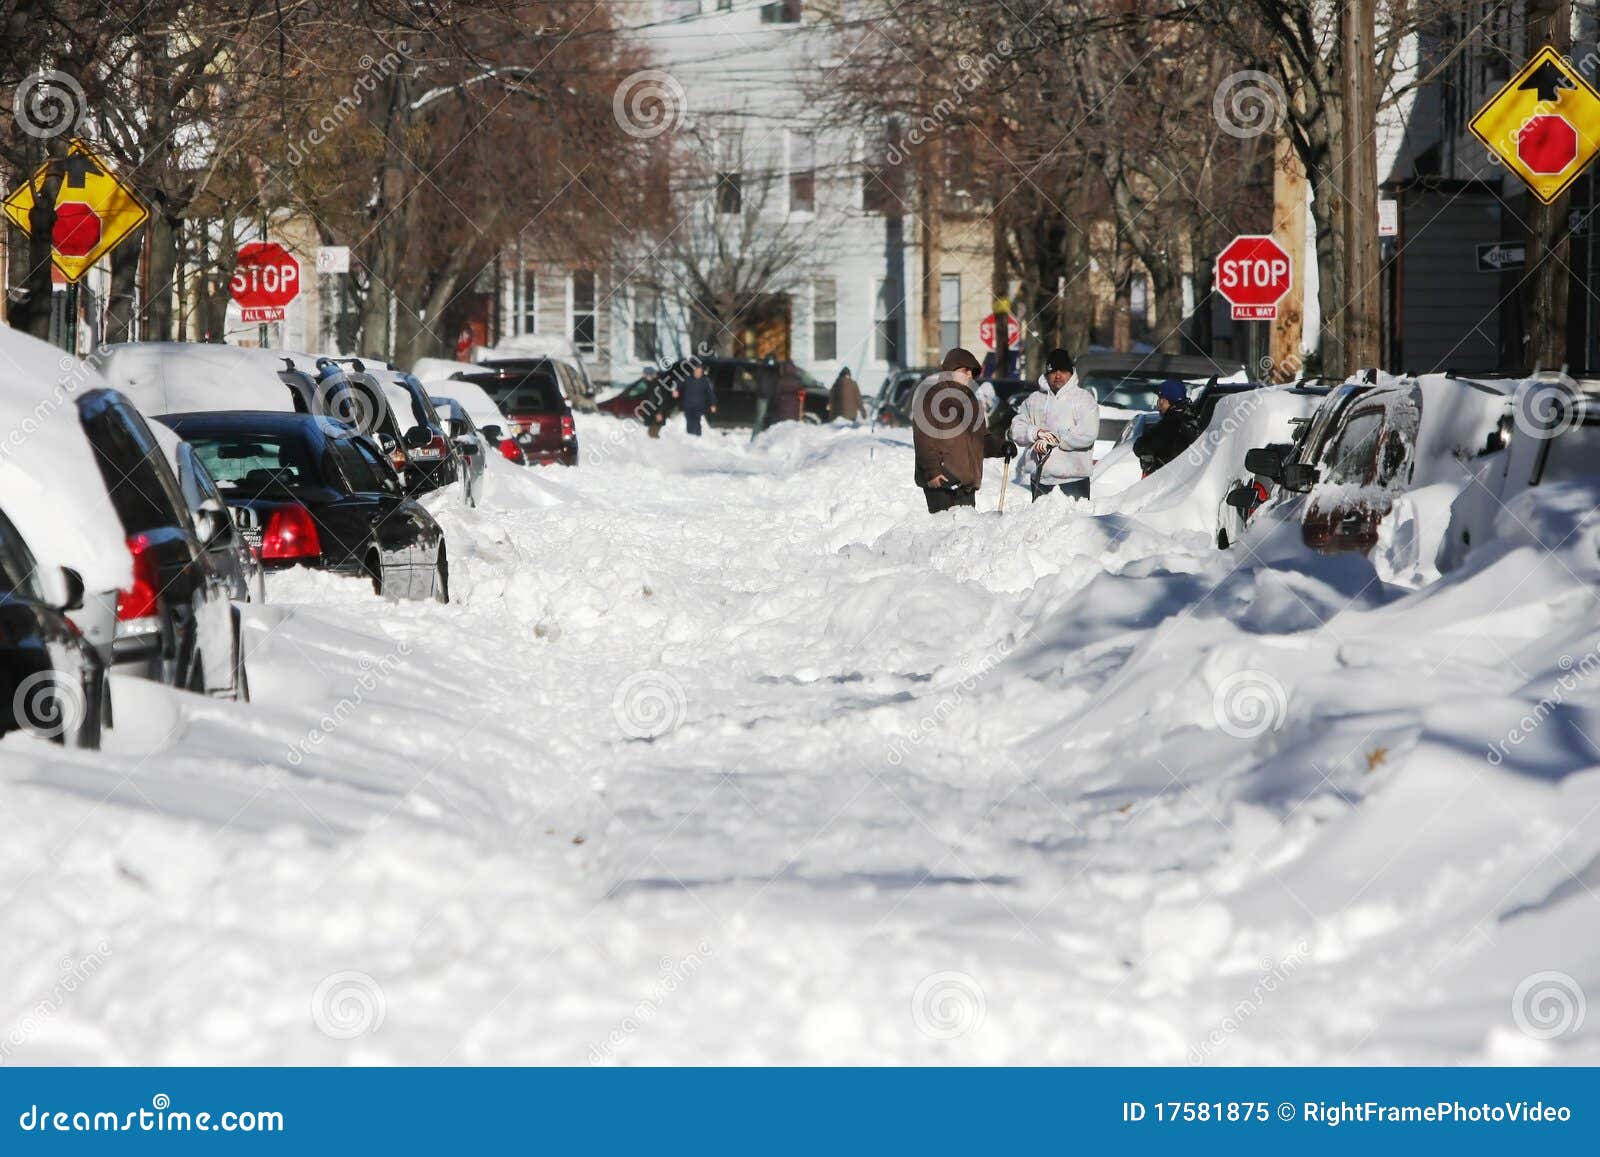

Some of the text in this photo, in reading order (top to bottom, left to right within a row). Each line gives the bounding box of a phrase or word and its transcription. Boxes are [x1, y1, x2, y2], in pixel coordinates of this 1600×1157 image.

[1489, 250, 1513, 264] ONE
[231, 264, 297, 292] STOP
[1223, 260, 1287, 287] STOP
[244, 310, 282, 320] ALL WAY
[1236, 307, 1273, 316] ALL WAY
[981, 323, 1016, 340] SP
